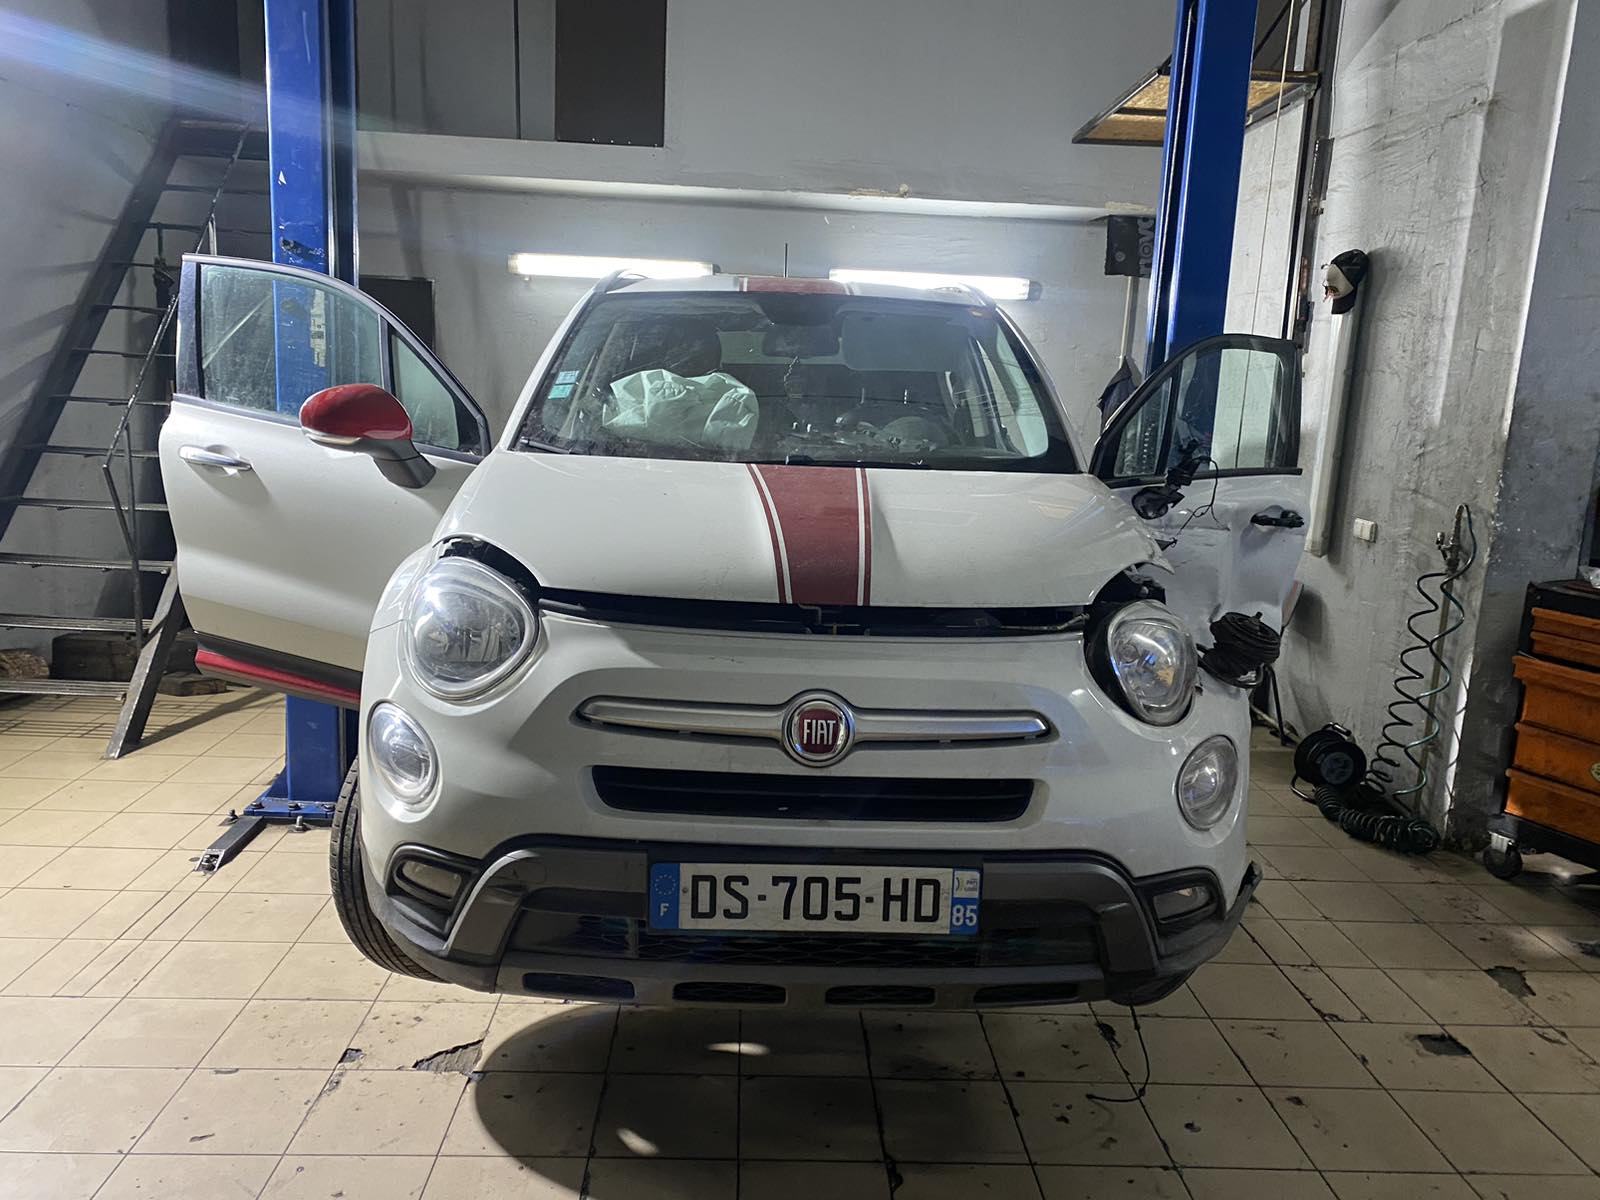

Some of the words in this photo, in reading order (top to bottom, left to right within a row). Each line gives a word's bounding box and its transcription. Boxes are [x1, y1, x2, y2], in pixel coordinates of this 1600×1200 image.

[803, 719, 836, 745] FIAT
[660, 903, 669, 916] F
[691, 875, 940, 922] DS-705-HD
[952, 904, 977, 926] 85
